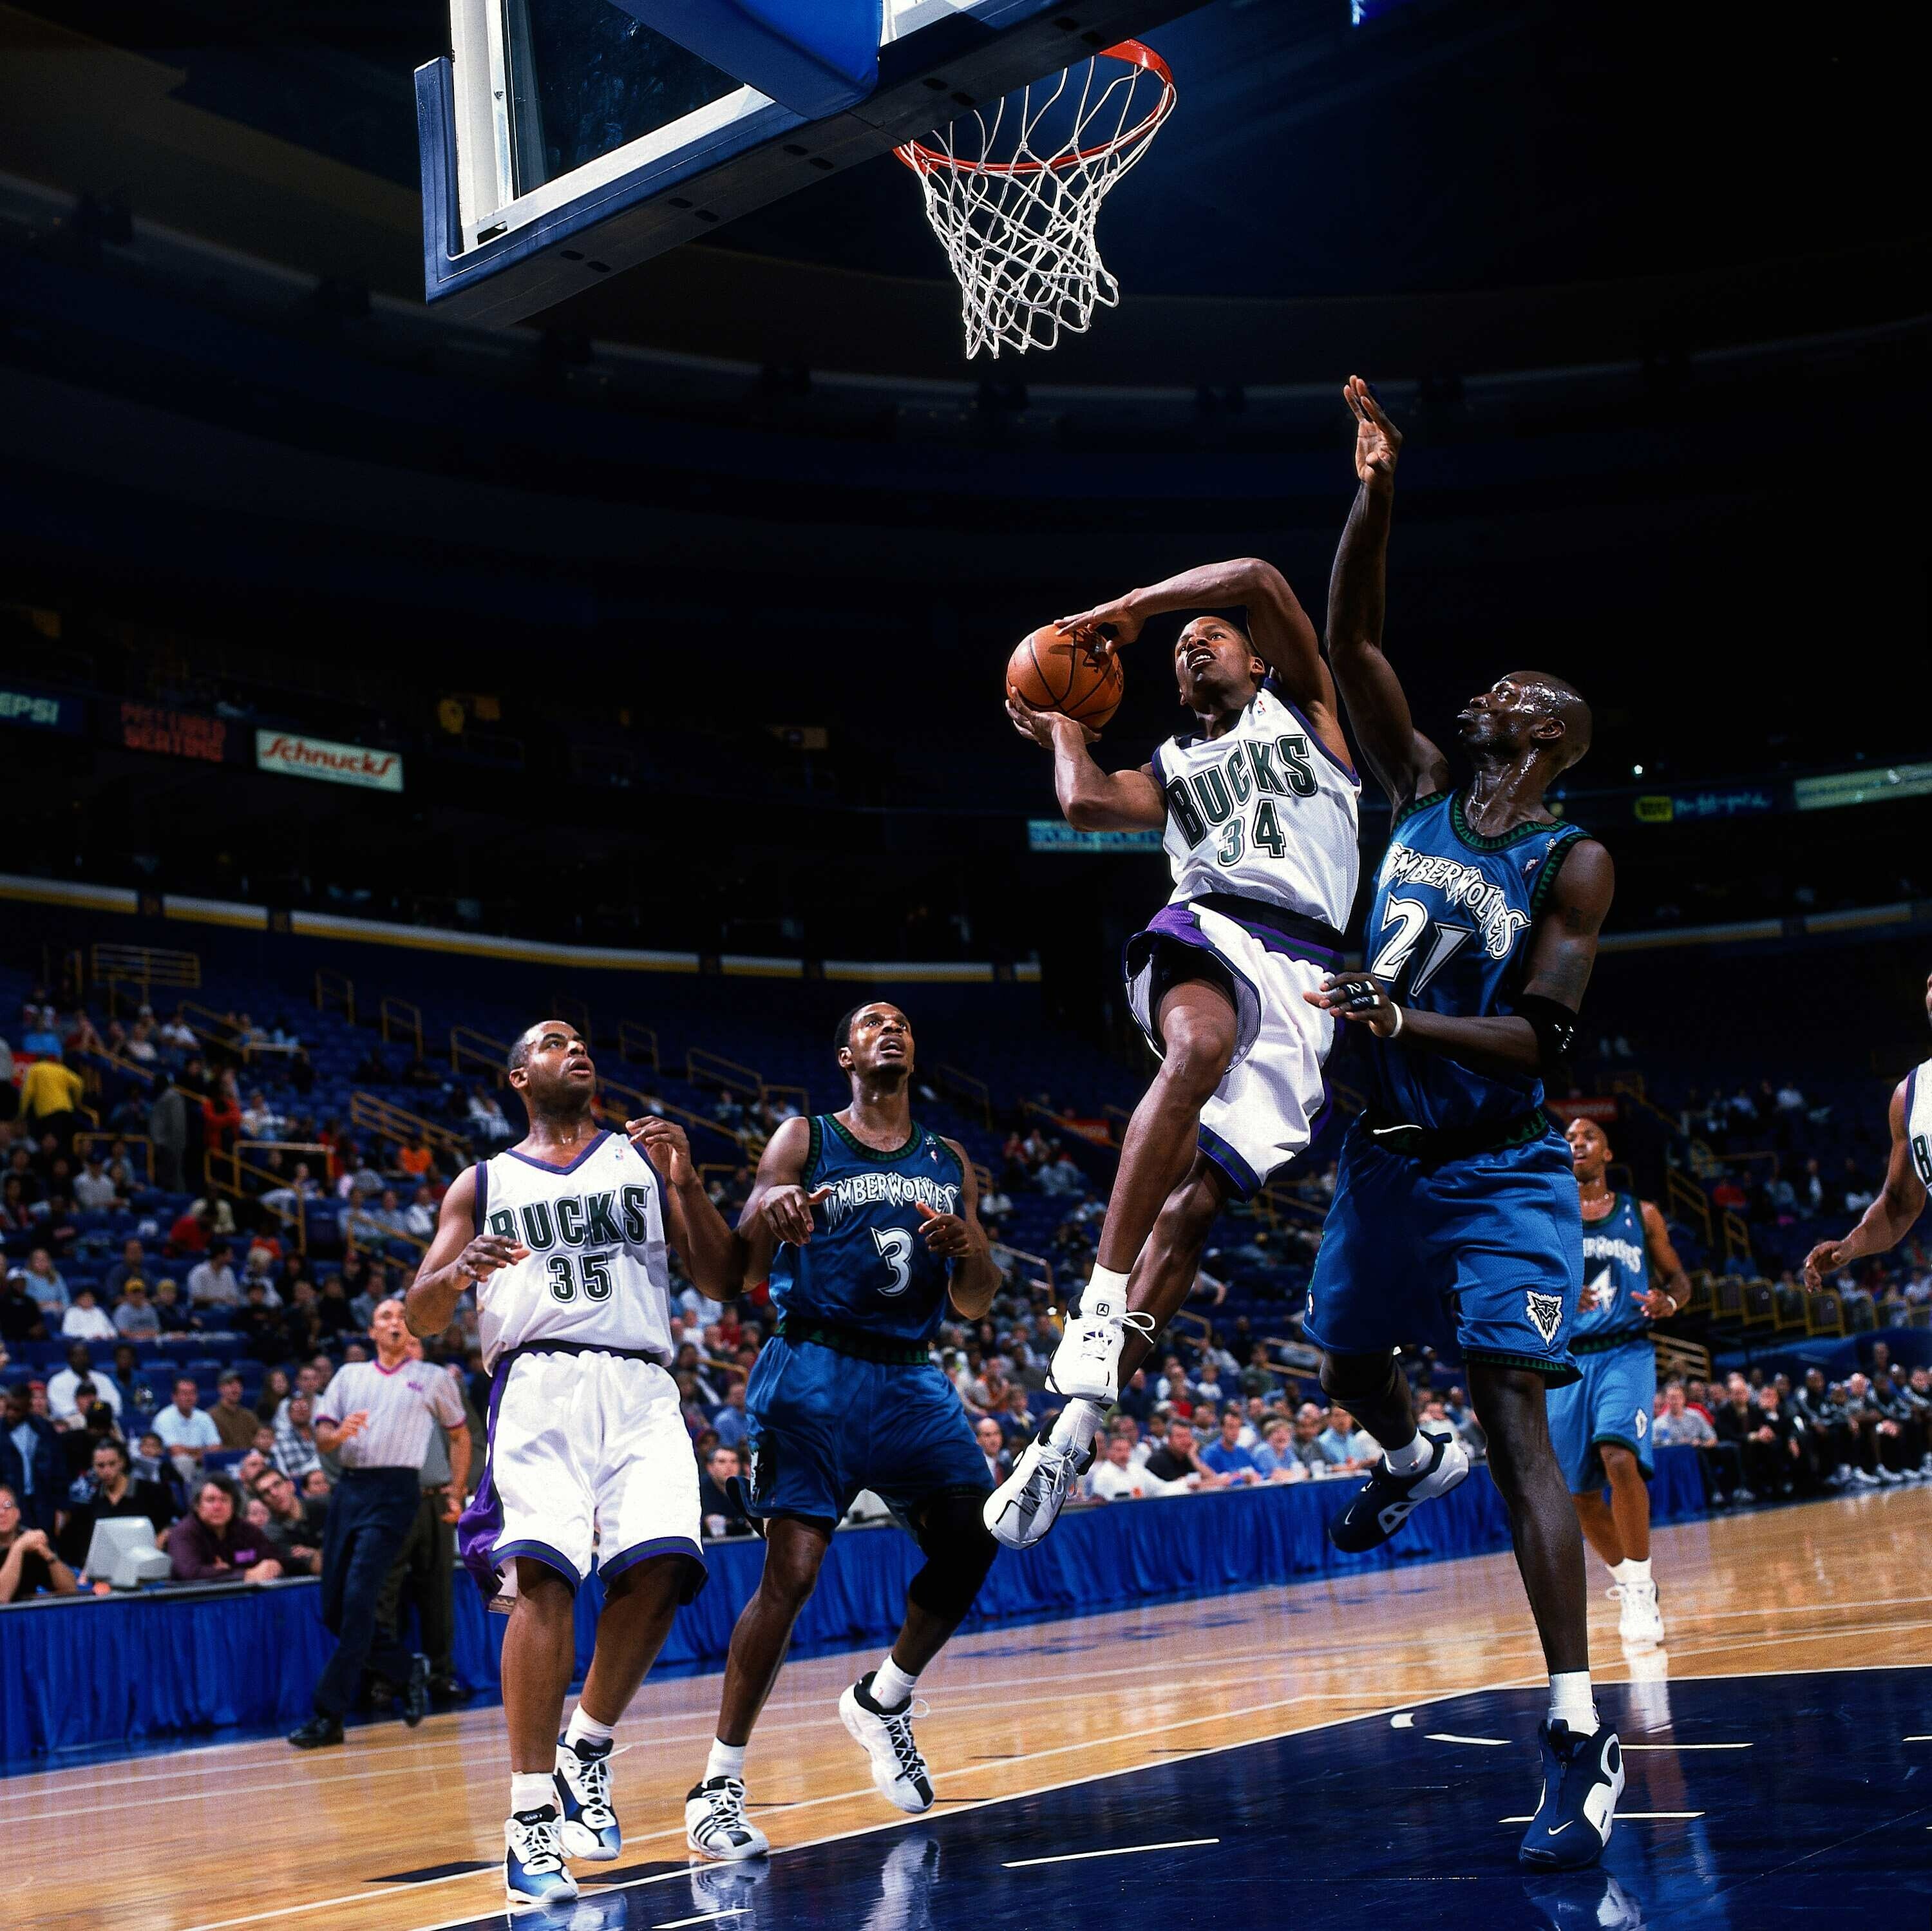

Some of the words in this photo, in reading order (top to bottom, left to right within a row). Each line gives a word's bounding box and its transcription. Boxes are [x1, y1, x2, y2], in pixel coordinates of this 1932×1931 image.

[261, 736, 398, 777] Schnucks
[1165, 734, 1319, 851] BUCKS
[1218, 799, 1286, 866] 34
[1370, 891, 1475, 998] 21
[484, 1184, 650, 1251] BUCKS
[814, 1172, 960, 1237] TIMBERWOLVES
[546, 1253, 612, 1303] 35
[871, 1226, 914, 1297] 3
[1588, 1264, 1618, 1312] 4
